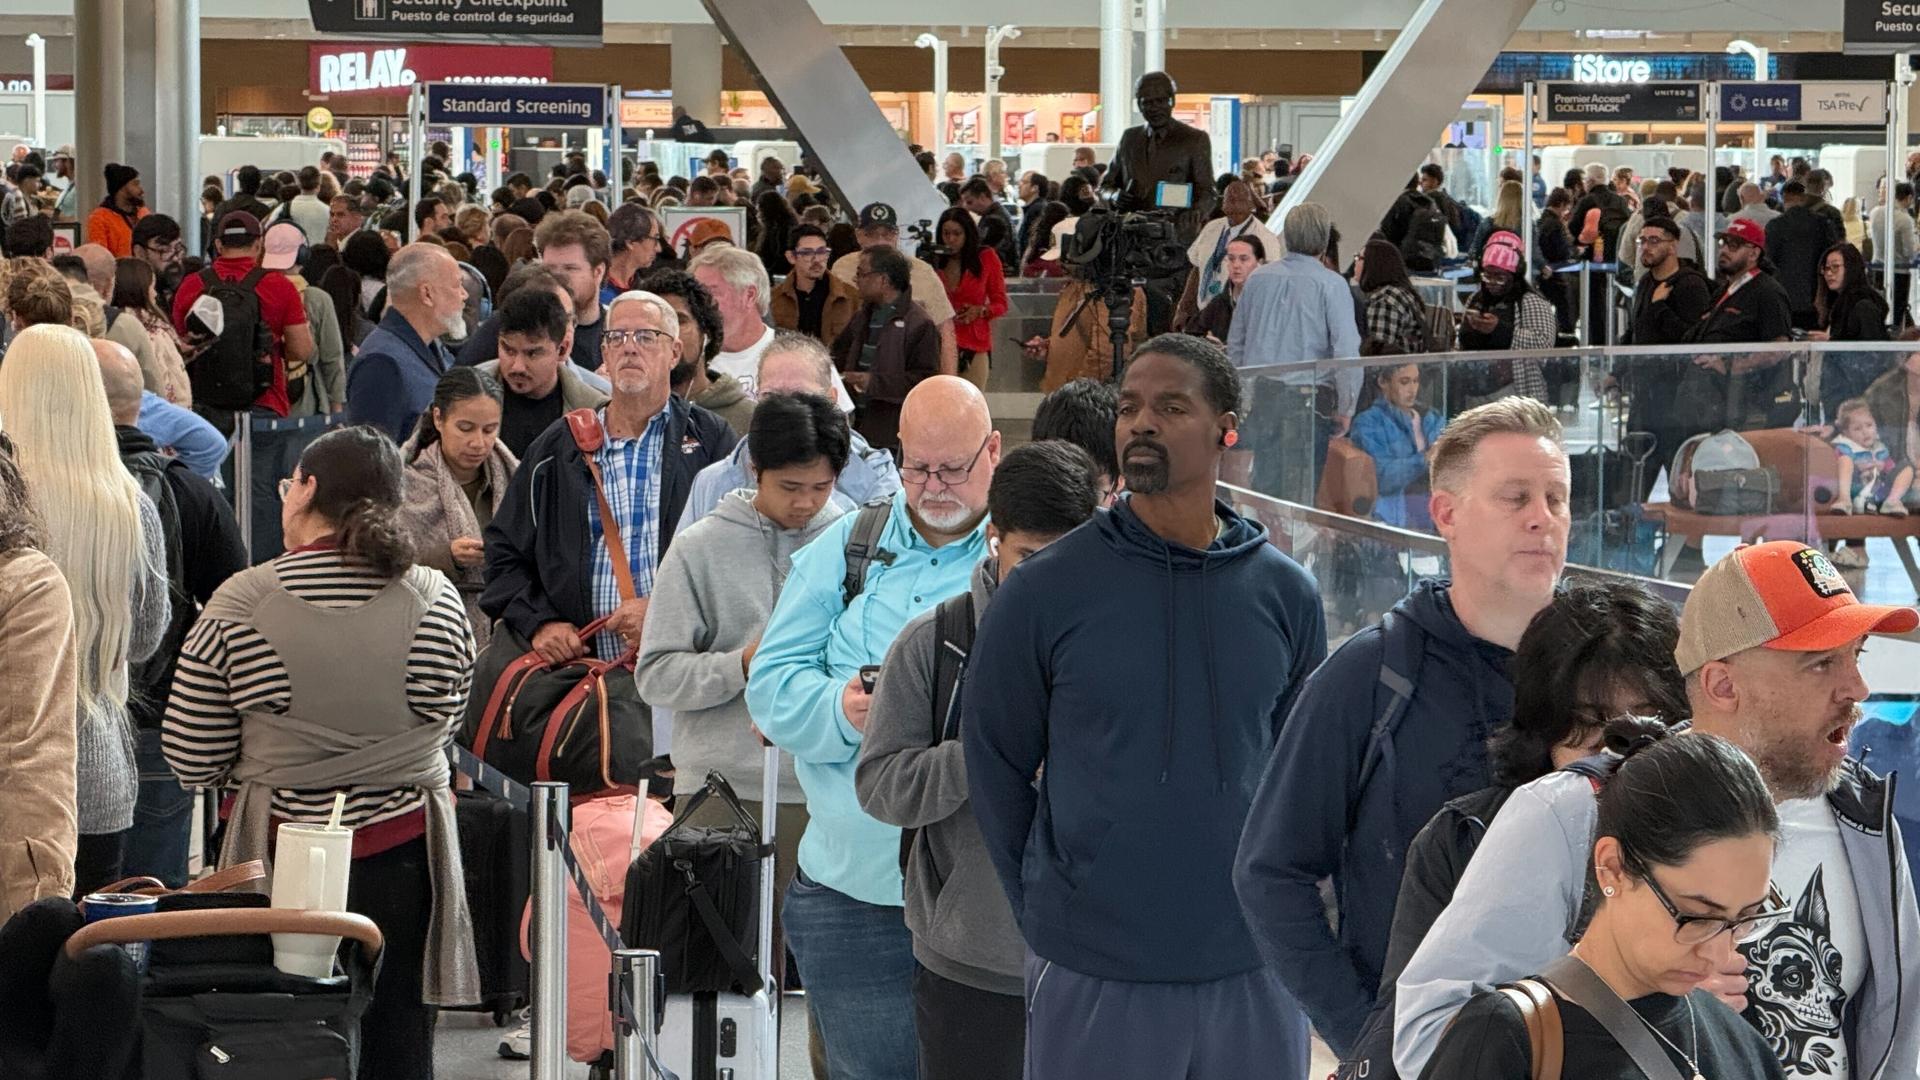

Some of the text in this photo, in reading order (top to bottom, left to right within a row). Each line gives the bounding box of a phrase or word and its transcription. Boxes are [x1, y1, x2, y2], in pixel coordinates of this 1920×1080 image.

[391, 10, 575, 25] Puesto de control de seguridad
[1875, 21, 1914, 32] Puesto
[1573, 54, 1650, 83] iStore
[1554, 94, 1591, 104] Premier
[1752, 98, 1789, 107] CLEAR
[442, 98, 591, 117] Standard Screening
[1555, 104, 1620, 112] GOLDTRACK
[1817, 100, 1836, 110] TSA
